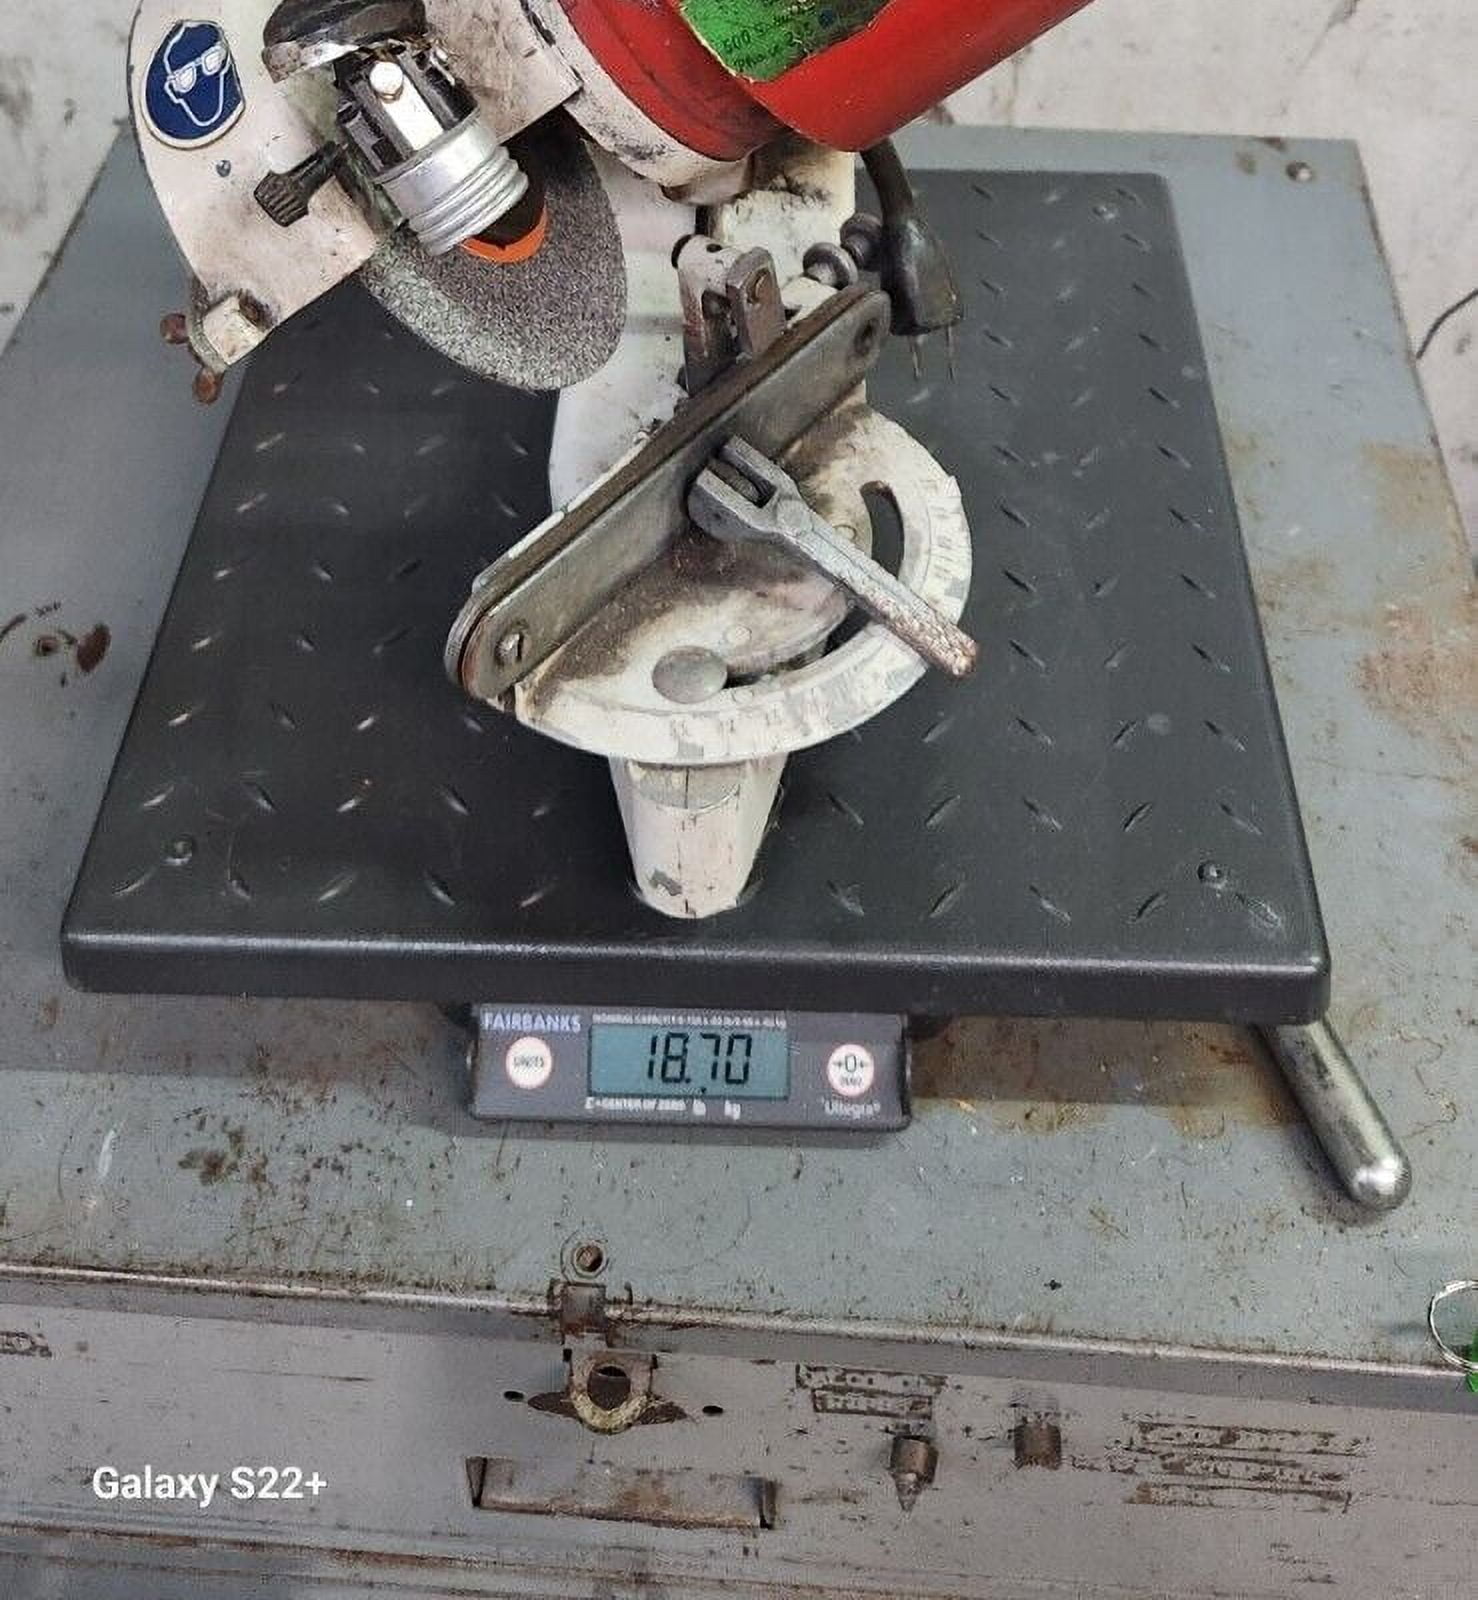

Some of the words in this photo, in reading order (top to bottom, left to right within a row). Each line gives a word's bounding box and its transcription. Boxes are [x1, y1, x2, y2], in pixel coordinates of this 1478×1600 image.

[483, 1012, 580, 1032] FAIRBANKS
[647, 1031, 753, 1086] 18.70
[724, 1099, 741, 1121] kg
